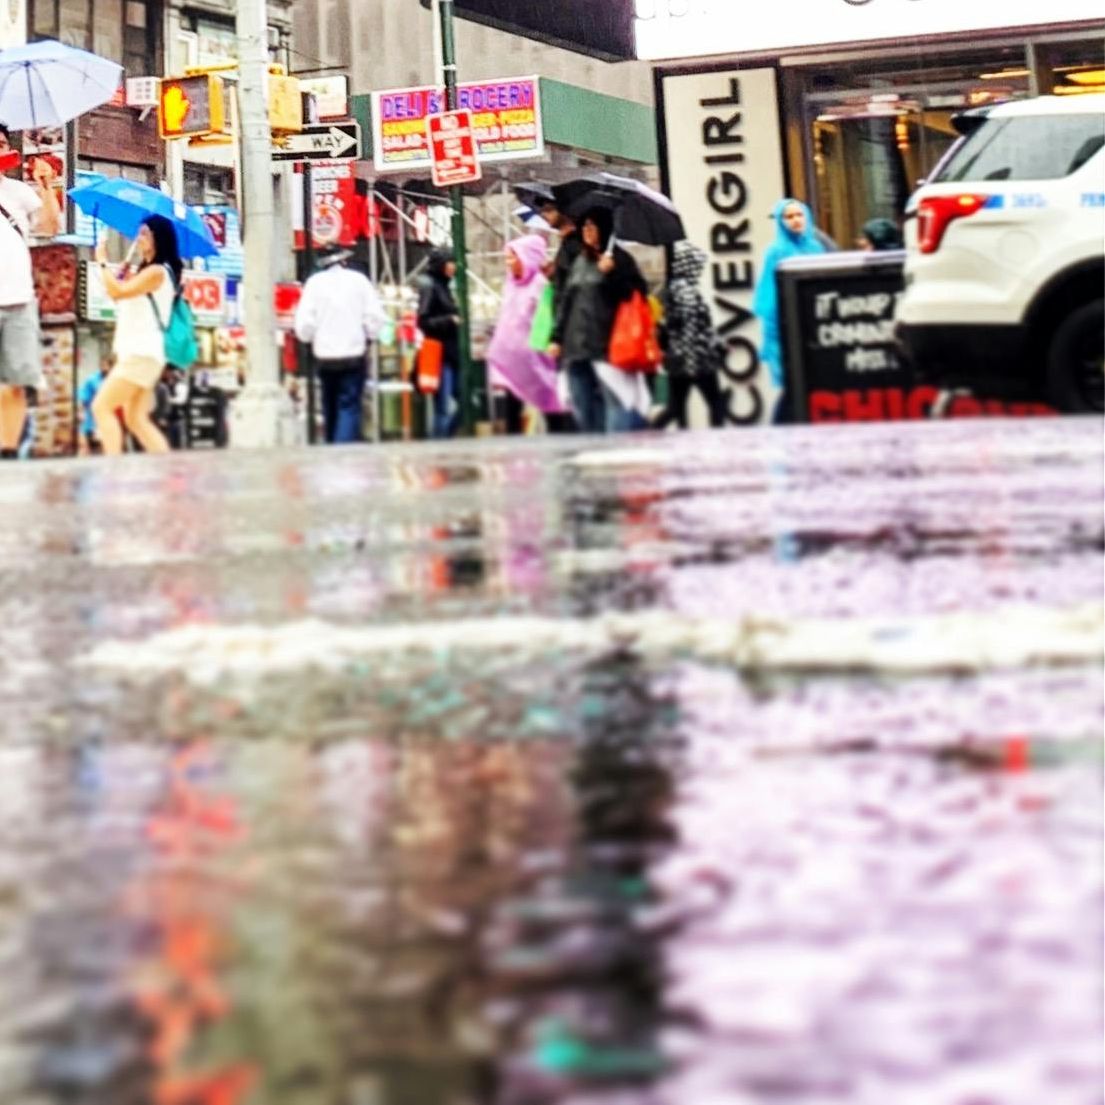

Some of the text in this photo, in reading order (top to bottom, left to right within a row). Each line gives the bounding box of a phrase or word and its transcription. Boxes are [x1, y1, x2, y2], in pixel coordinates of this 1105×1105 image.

[382, 84, 532, 119] DELI & ROCERY
[439, 115, 460, 131] NO
[311, 135, 345, 149] WAY
[698, 77, 763, 426] COVERGIRL
